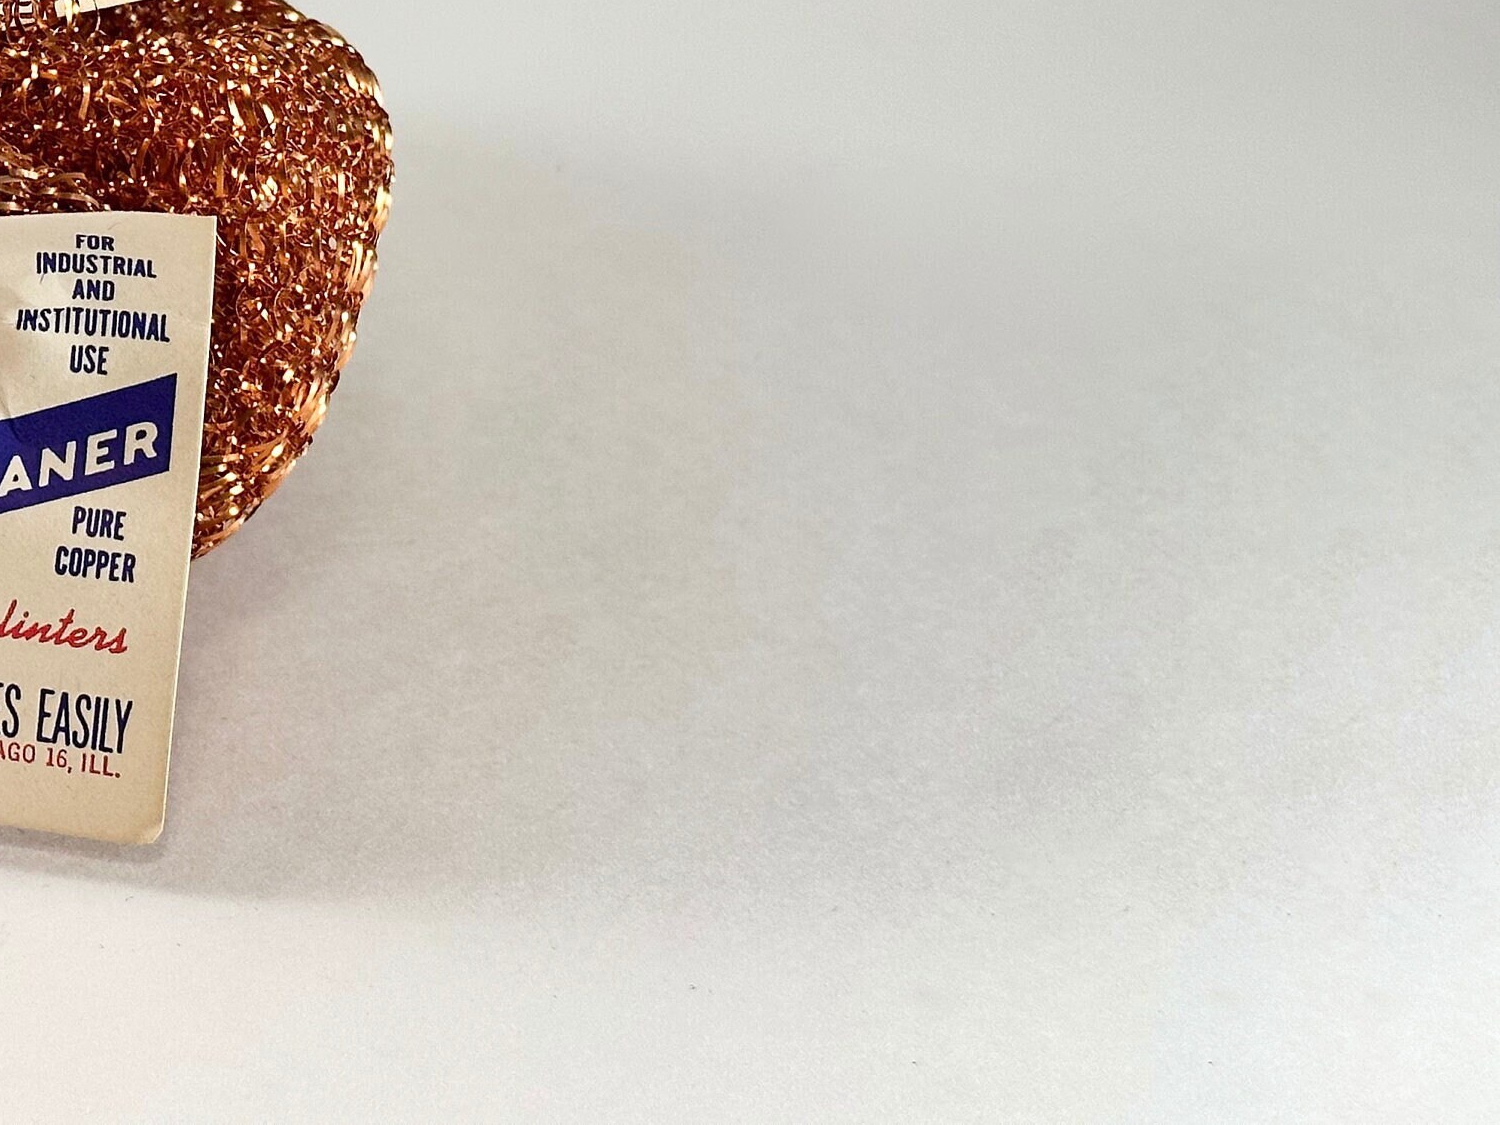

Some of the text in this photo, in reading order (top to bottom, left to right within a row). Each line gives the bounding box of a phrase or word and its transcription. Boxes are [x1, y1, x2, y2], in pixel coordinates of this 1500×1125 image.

[75, 234, 115, 251] FOR
[36, 252, 157, 278] INDUSTRIAL
[72, 279, 115, 302] AND
[16, 307, 170, 343] INSTITUTIONAL
[70, 345, 109, 375] USE
[71, 505, 127, 541] PURE
[54, 545, 136, 583] COPPER
[38, 689, 133, 754] EASILY
[45, 747, 73, 774] 16,
[81, 752, 122, 779] ILL.
